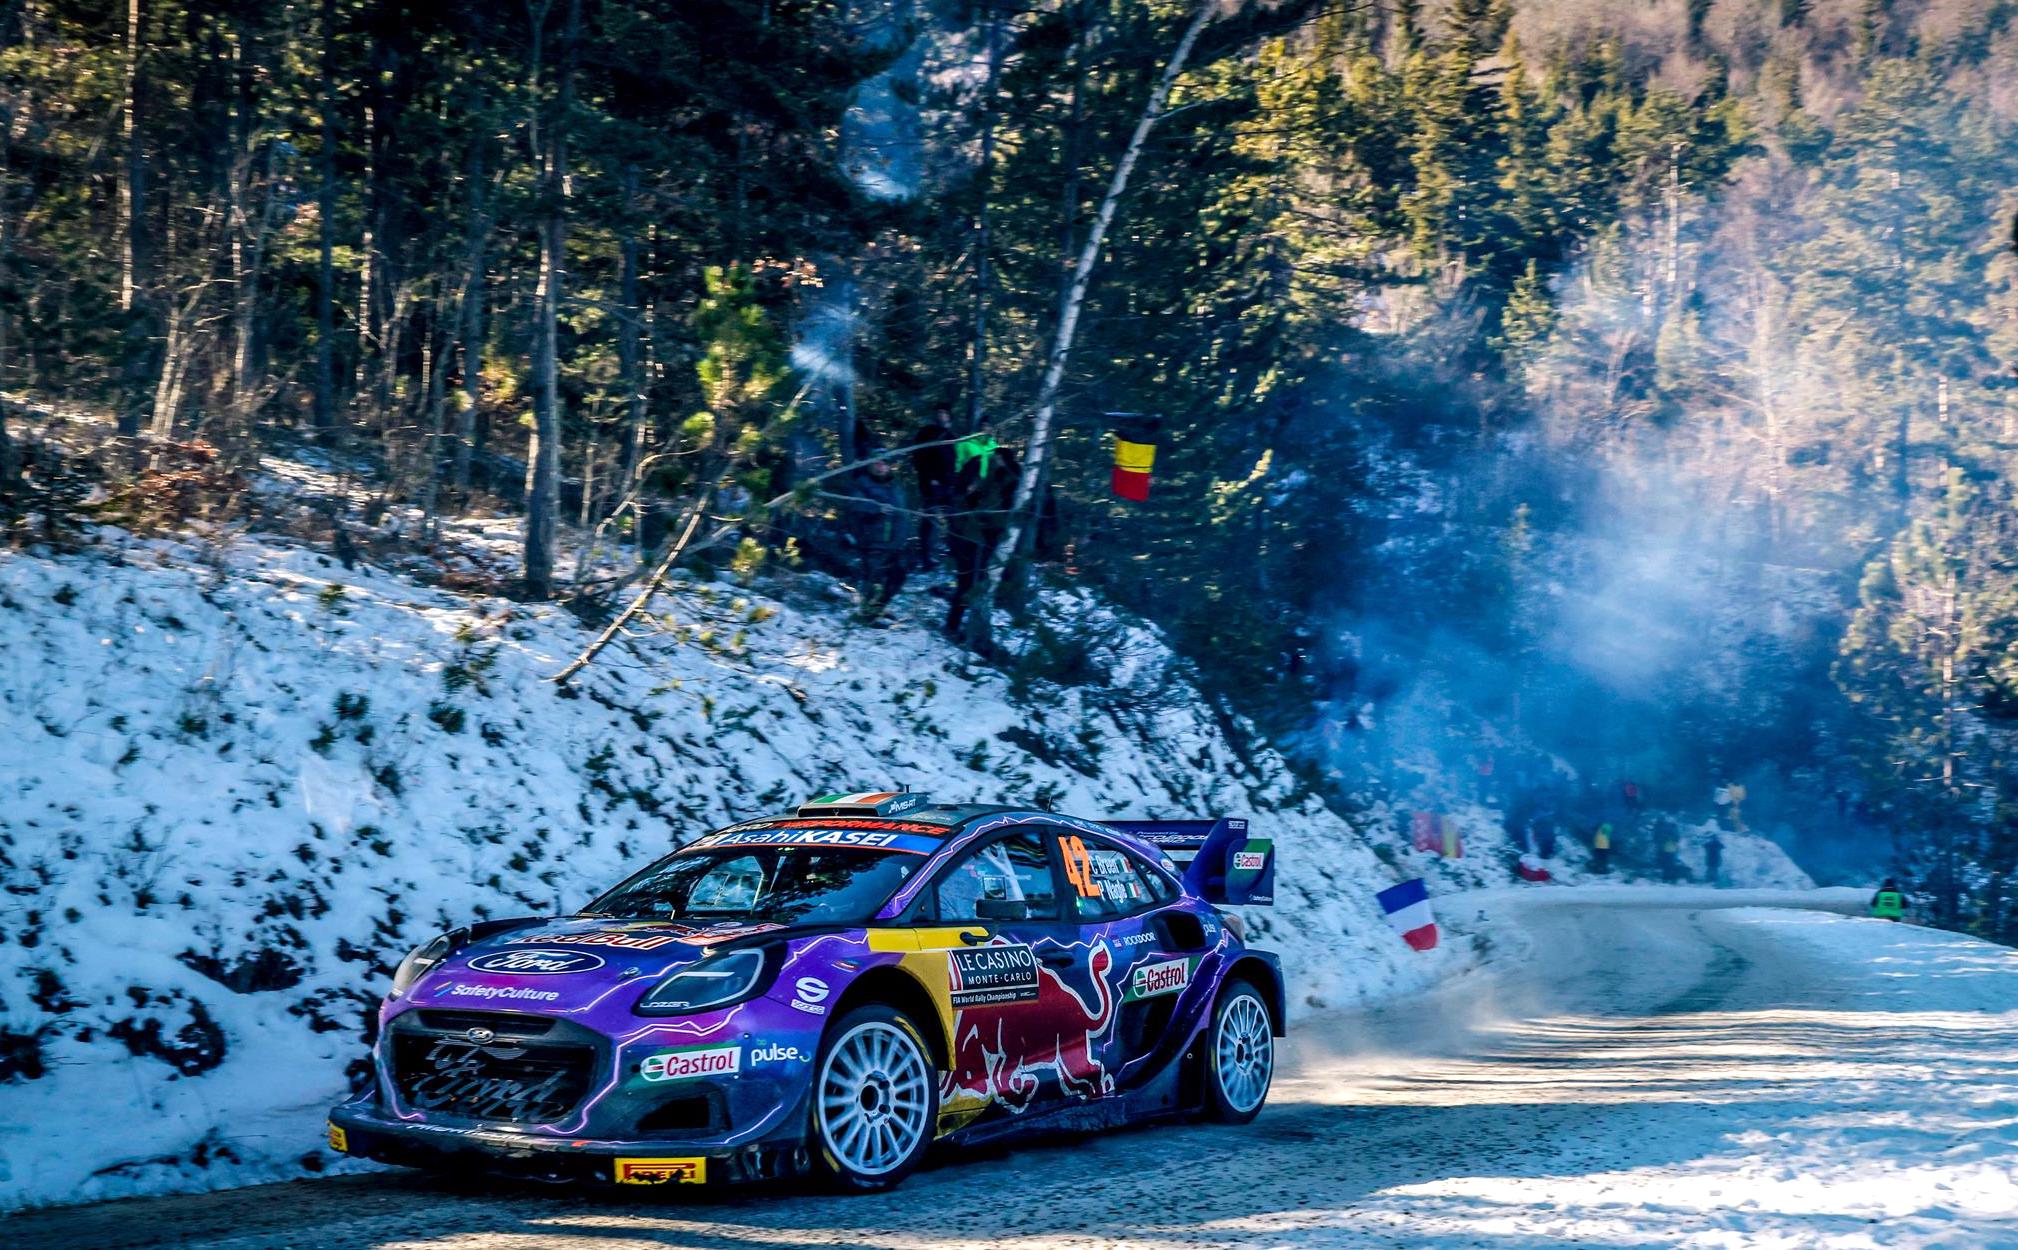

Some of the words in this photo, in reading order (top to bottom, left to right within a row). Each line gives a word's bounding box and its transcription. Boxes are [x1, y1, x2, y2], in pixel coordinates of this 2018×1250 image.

[1058, 835, 1101, 897] 42
[486, 951, 585, 971] Ford
[956, 954, 975, 971] LE
[975, 950, 1032, 970] CASINO
[1147, 963, 1185, 992] Castrol
[451, 985, 559, 1001] SafetyCulture
[962, 995, 975, 1003] World
[987, 992, 1016, 1002] Championship
[667, 1051, 734, 1076] Castrol
[751, 1043, 798, 1066] pulse
